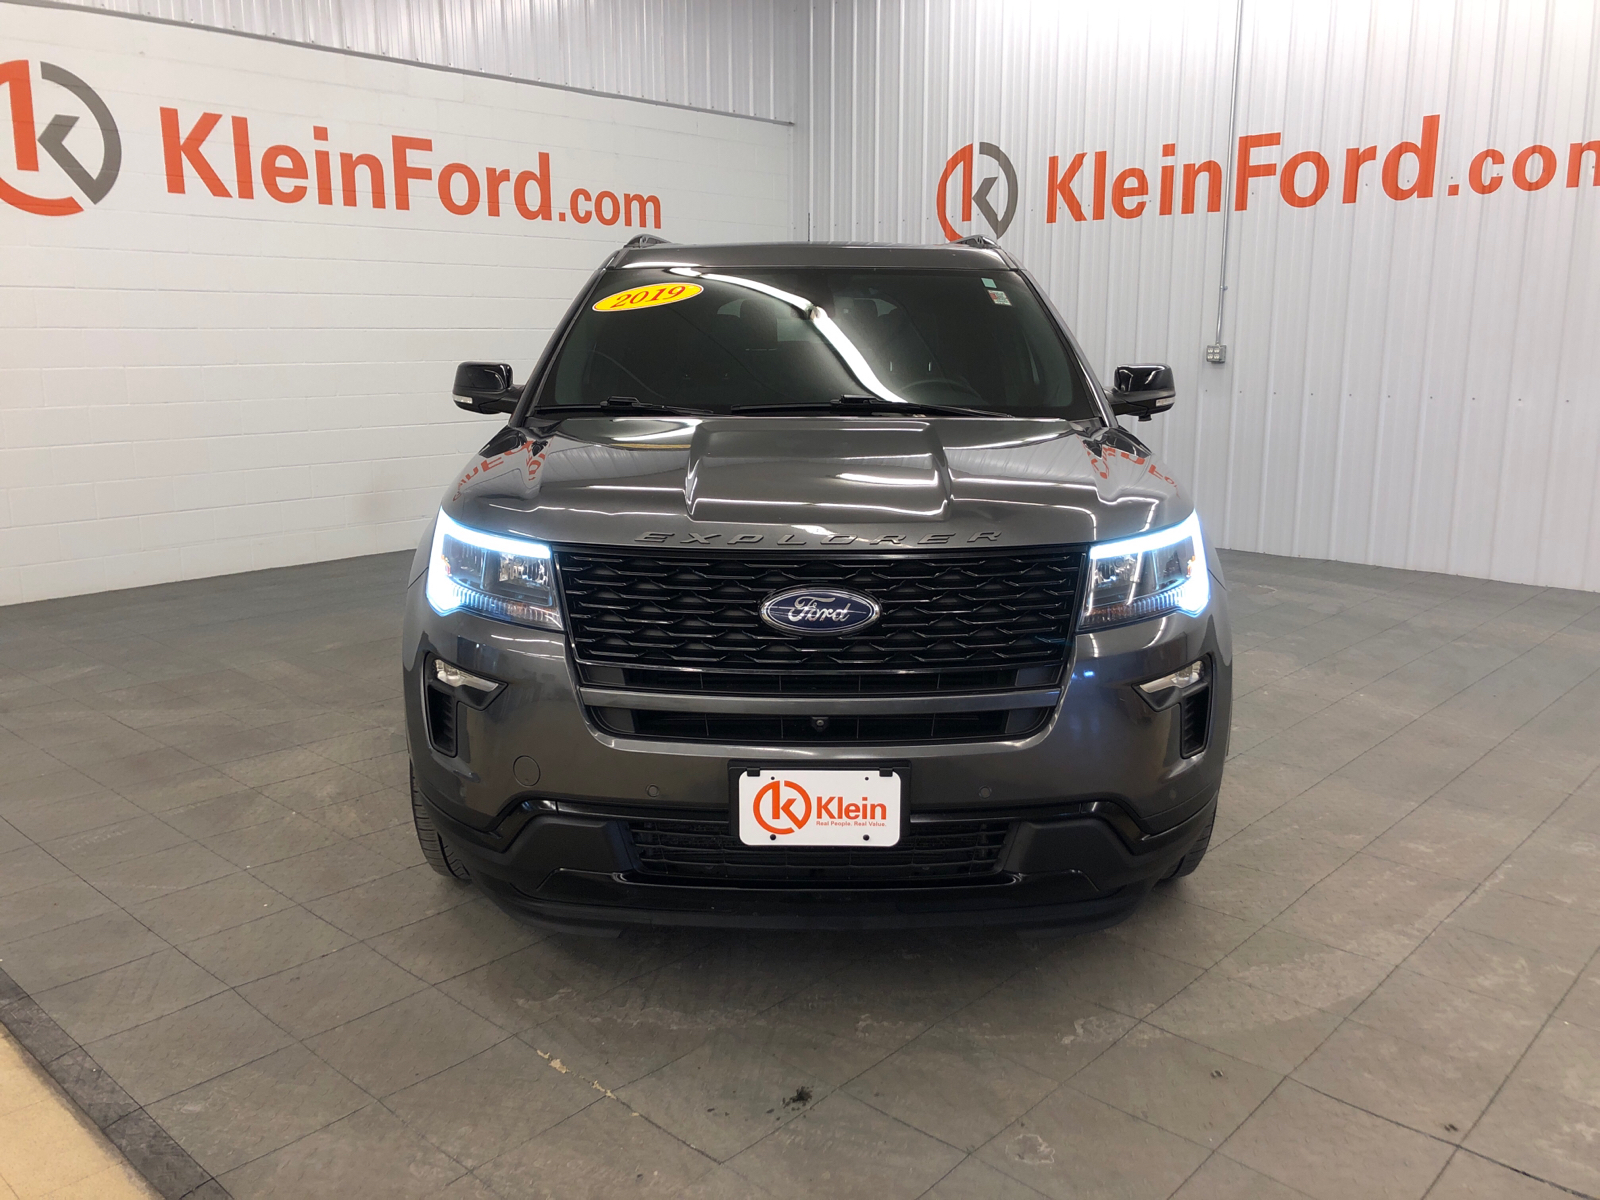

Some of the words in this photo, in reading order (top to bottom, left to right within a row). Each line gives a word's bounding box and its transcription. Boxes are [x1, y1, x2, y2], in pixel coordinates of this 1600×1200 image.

[160, 106, 662, 229] KleinFord.com
[610, 286, 686, 309] 2019
[634, 531, 1002, 546] EXPLORER
[787, 596, 851, 623] Ford
[816, 796, 887, 820] Klein
